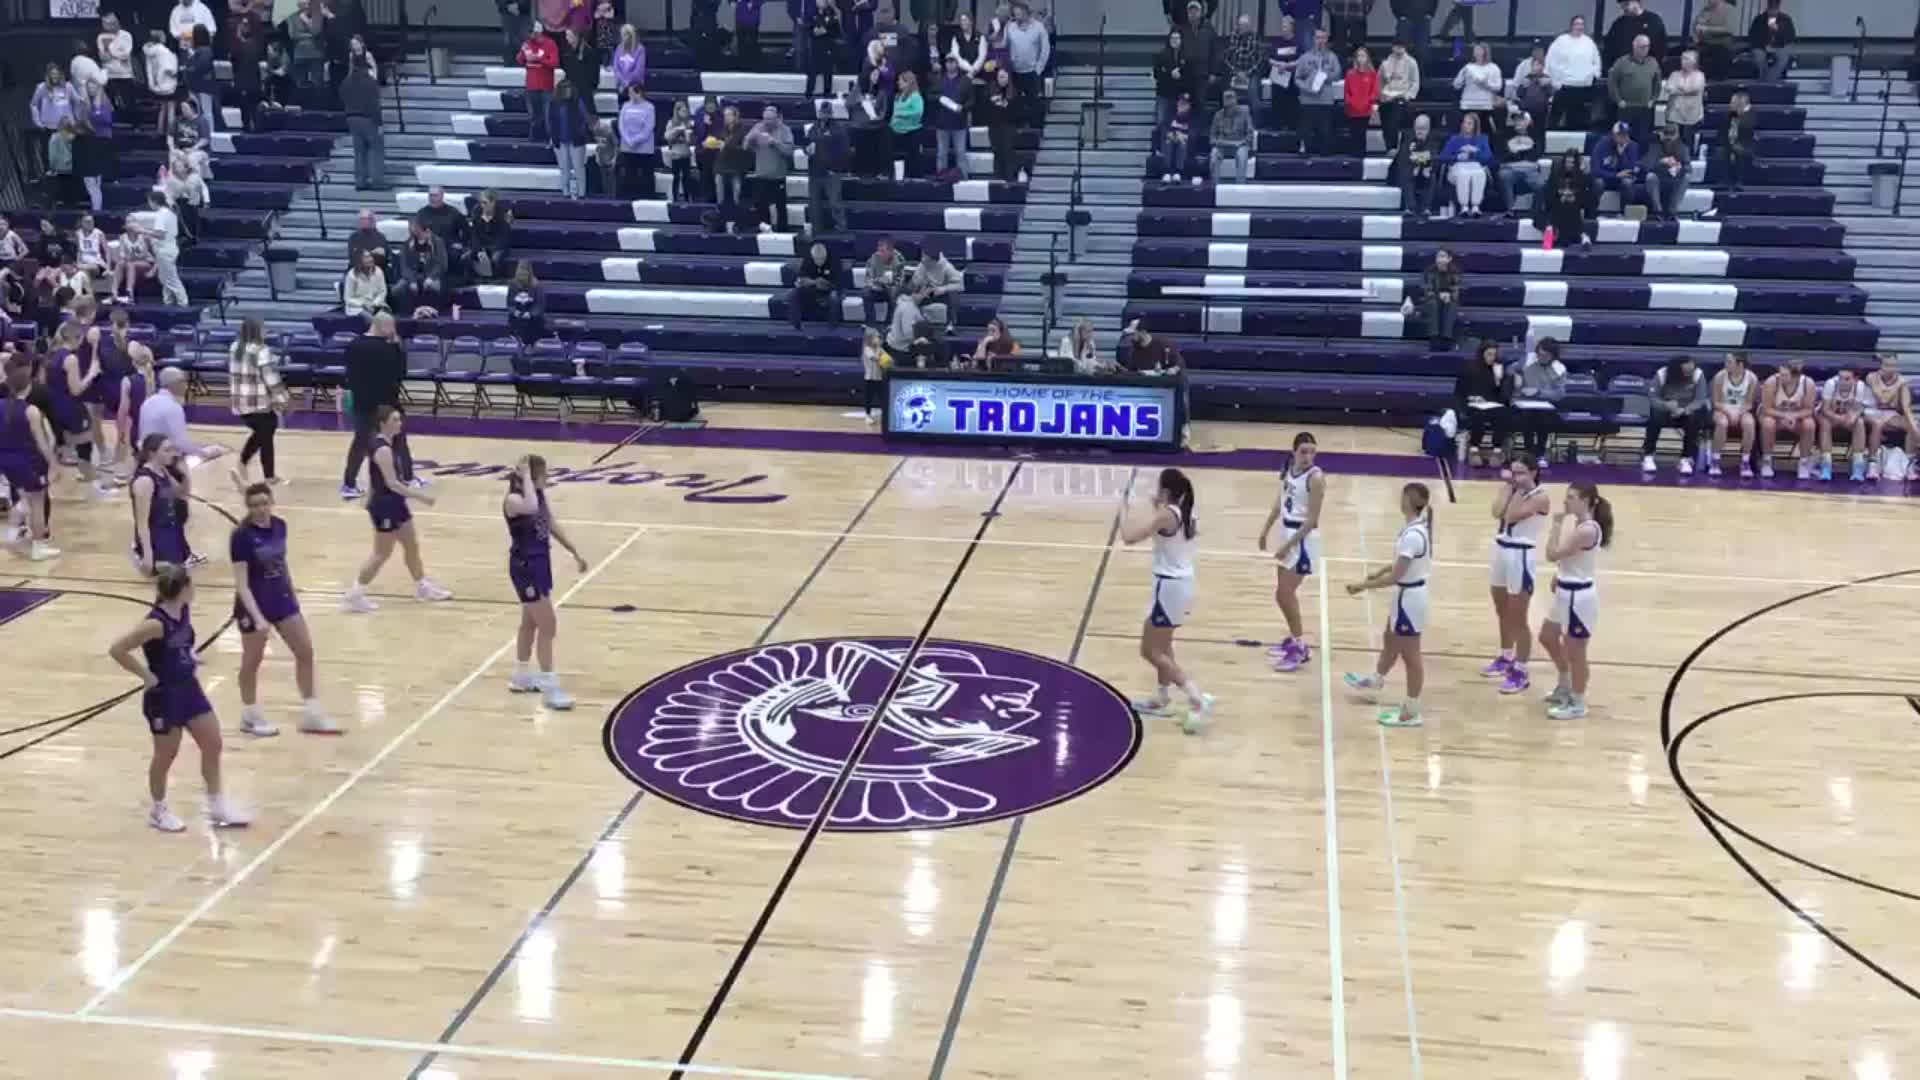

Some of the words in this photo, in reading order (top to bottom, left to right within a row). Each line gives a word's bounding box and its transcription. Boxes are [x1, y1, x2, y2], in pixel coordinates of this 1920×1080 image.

[994, 386, 1048, 399] HOME
[1051, 389, 1073, 400] OF
[1079, 389, 1119, 401] THE
[947, 400, 1162, 438] TROJANS
